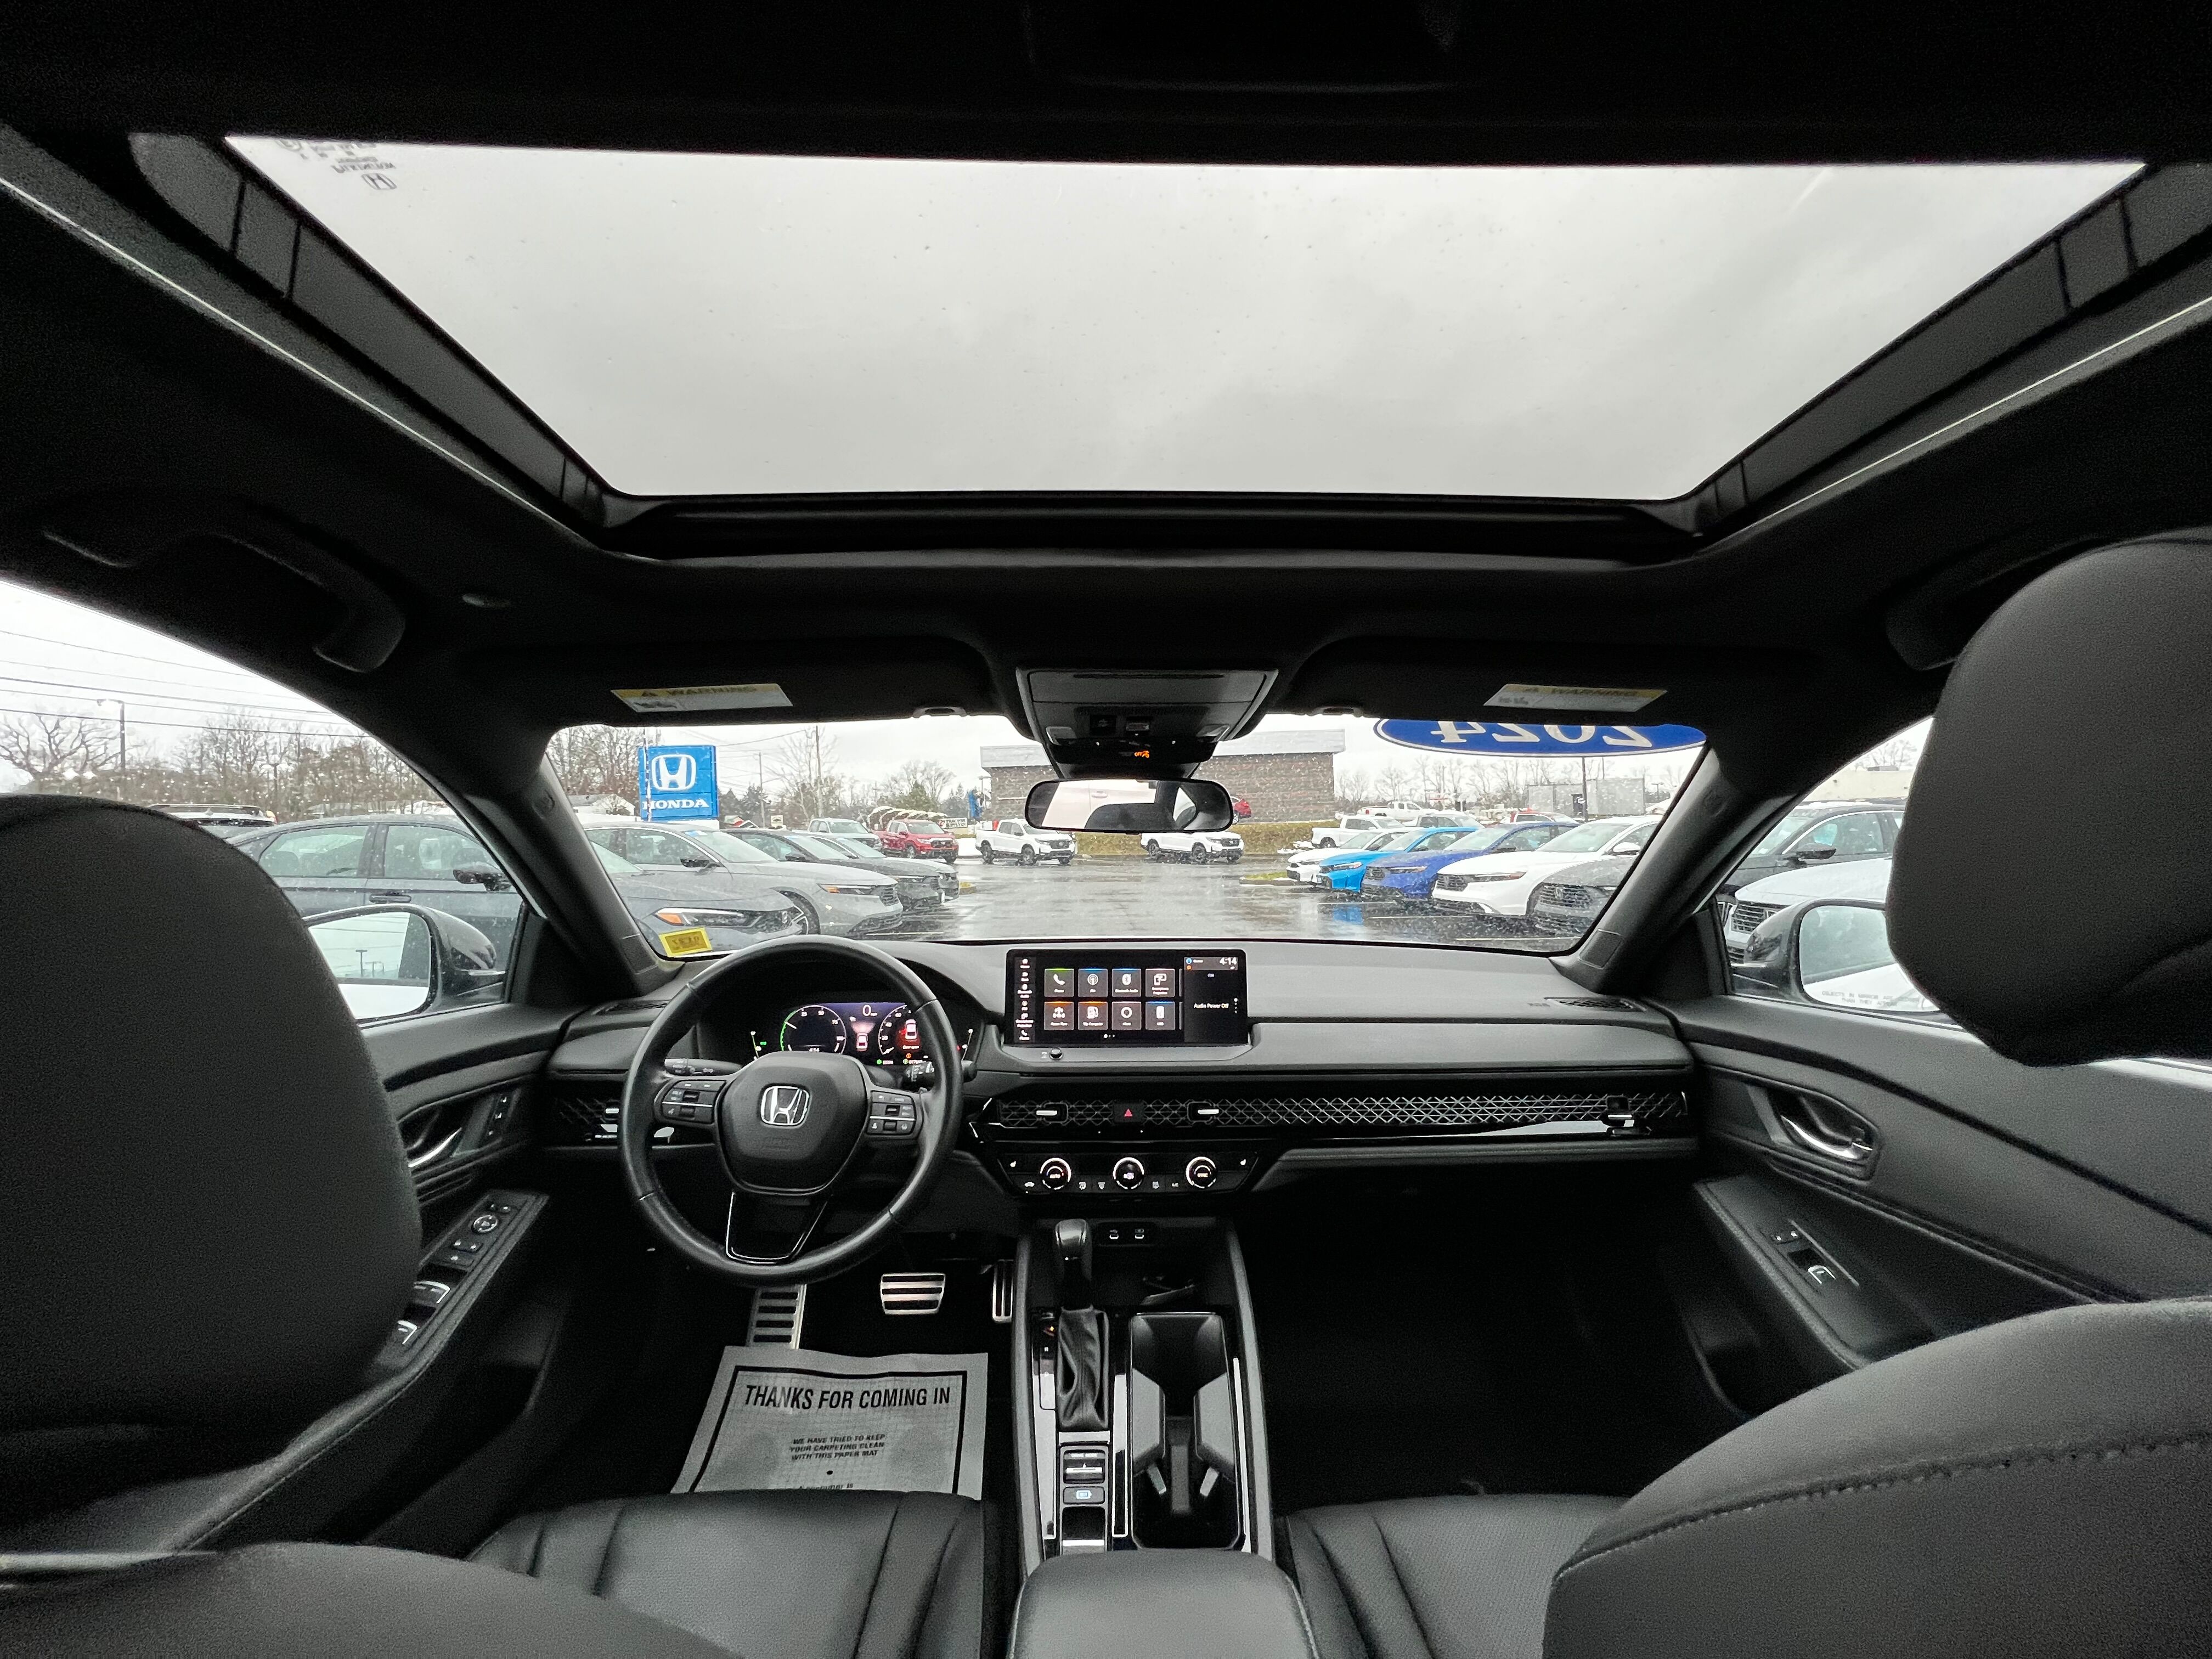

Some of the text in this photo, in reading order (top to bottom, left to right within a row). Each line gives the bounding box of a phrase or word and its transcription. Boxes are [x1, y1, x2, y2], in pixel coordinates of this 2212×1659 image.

[641, 799, 709, 810] HONDA
[1219, 957, 1237, 965] 4:14
[862, 1005, 871, 1017] 0
[745, 1385, 950, 1410] THANKS FOR COMING IN
